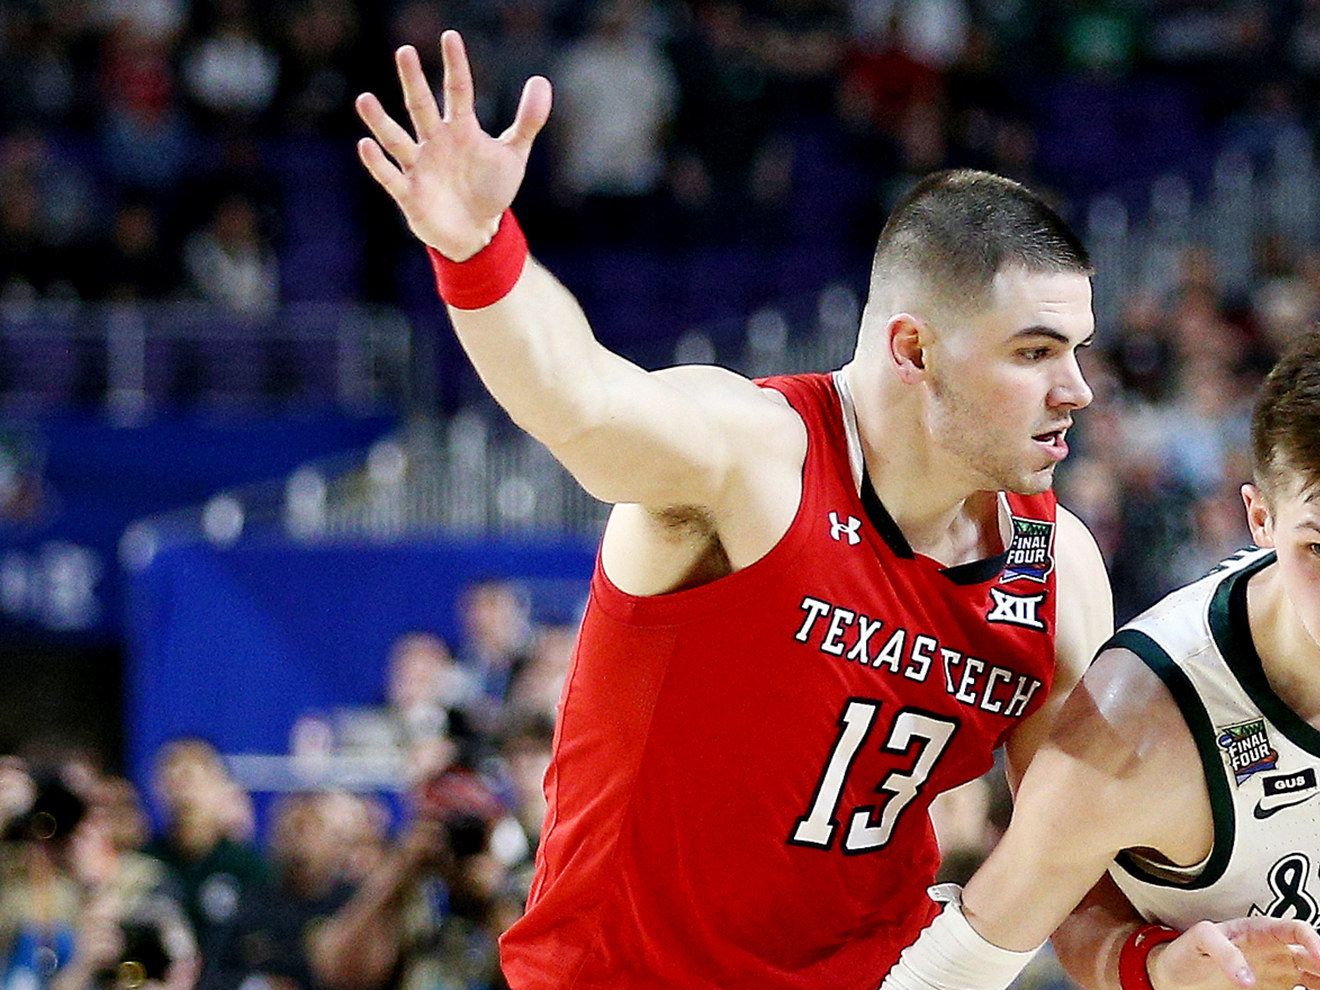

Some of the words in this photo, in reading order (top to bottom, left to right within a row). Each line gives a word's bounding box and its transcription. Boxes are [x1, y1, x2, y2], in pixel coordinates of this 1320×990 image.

[1006, 548, 1045, 565] FOUR
[794, 597, 940, 682] TEXAS
[939, 647, 1042, 718] TECH
[1229, 732, 1267, 758] FINAL
[1232, 743, 1270, 771] FOUR
[788, 699, 958, 853] 13
[1274, 776, 1305, 790] GUS
